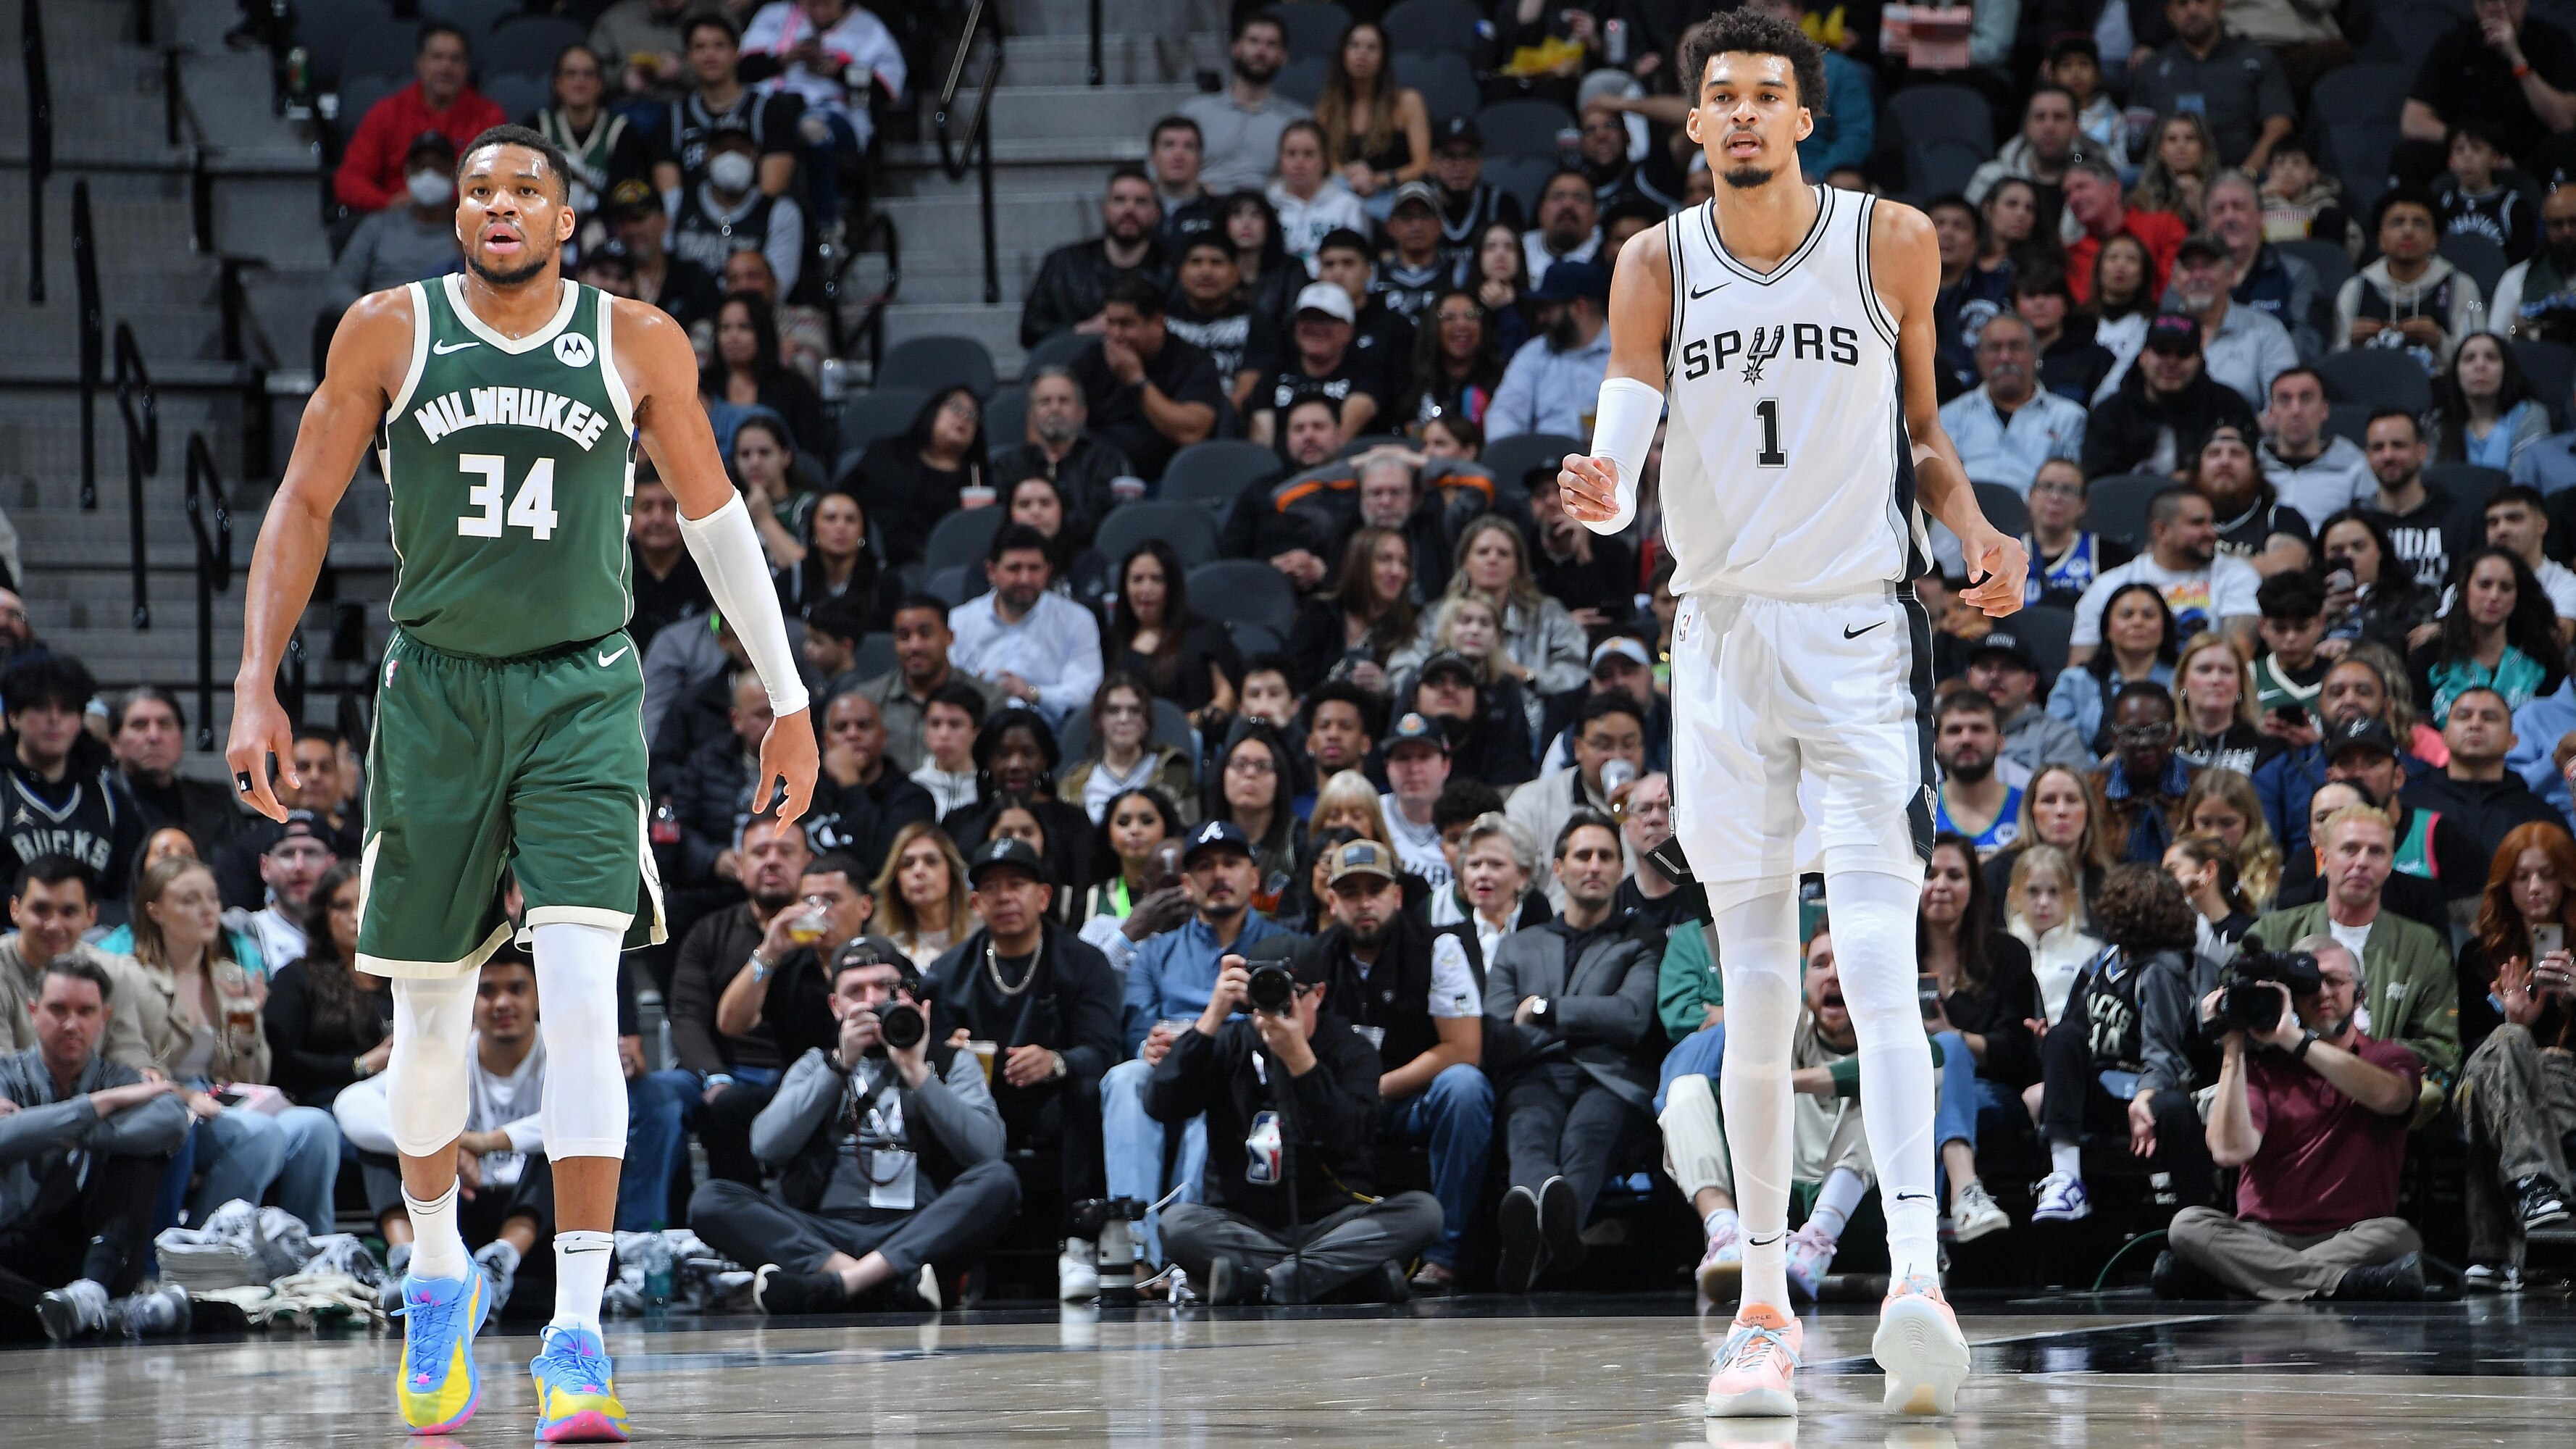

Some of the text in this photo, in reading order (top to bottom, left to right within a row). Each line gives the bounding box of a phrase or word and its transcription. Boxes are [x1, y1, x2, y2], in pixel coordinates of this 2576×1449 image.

[1683, 322, 1860, 387] SPURS
[414, 386, 609, 452] MILWAUKEE
[1753, 397, 1788, 469] 1
[458, 453, 558, 540] 34
[11, 829, 112, 871] BUCKS
[2086, 992, 2133, 1035] UCKS
